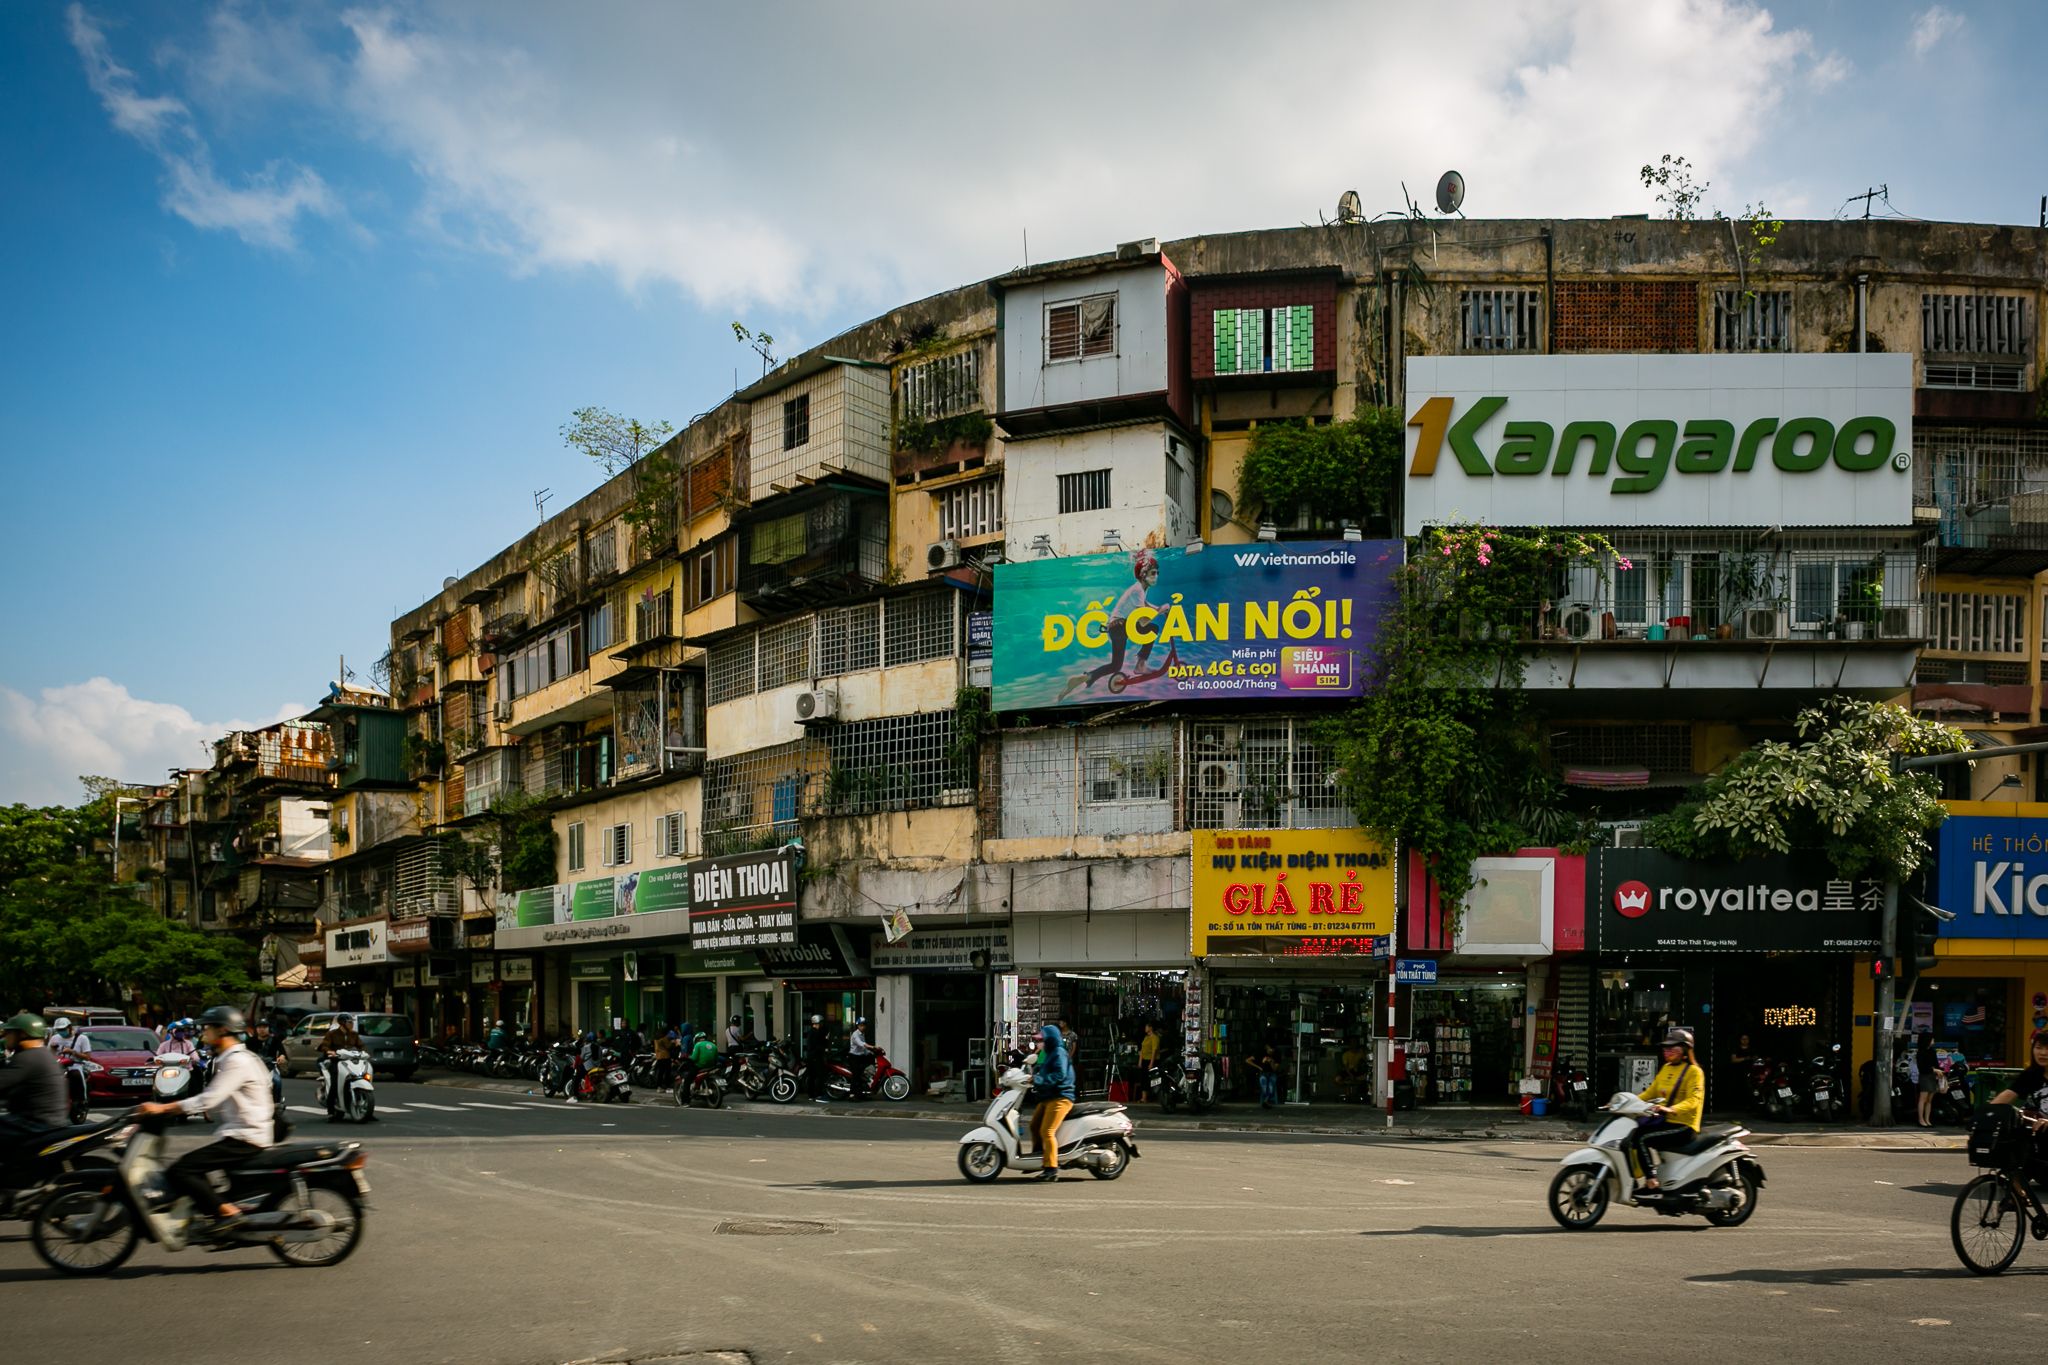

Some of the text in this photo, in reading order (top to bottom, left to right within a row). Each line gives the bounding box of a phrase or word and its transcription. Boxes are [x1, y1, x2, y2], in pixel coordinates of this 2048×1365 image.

[1261, 551, 1357, 566] vietnamobile
[1041, 586, 1353, 652] ĐỐ CẢN NỔI!
[1232, 648, 1277, 660] Miễn phí
[1293, 648, 1323, 662] SIÊU
[1168, 659, 1277, 678] DATA 4G & GỌI
[1293, 661, 1340, 674] THÁNH
[1238, 835, 1272, 849] VÀNG
[1972, 833, 1993, 854] HỆ
[1241, 851, 1282, 871] KIỆN
[1287, 850, 1329, 871] ĐIỆN
[693, 860, 789, 907] ĐIỆN THOẠI
[1222, 869, 1365, 915] GIÁ RẺ
[1659, 884, 1819, 916] royaltea
[693, 921, 707, 934] MUA
[707, 918, 720, 932] BÁN
[736, 913, 754, 930] CHỮA
[759, 915, 776, 928] THAY
[776, 911, 793, 927] KÍNH
[1223, 921, 1234, 931] SỐ
[1247, 921, 1262, 931] TÔN
[1265, 921, 1284, 930] THẤT
[1286, 921, 1307, 930] TÙNG
[1327, 922, 1350, 930] 01234
[703, 957, 736, 968] Vietcombank
[1397, 969, 1436, 980] TÔN THẤT TÙNG
